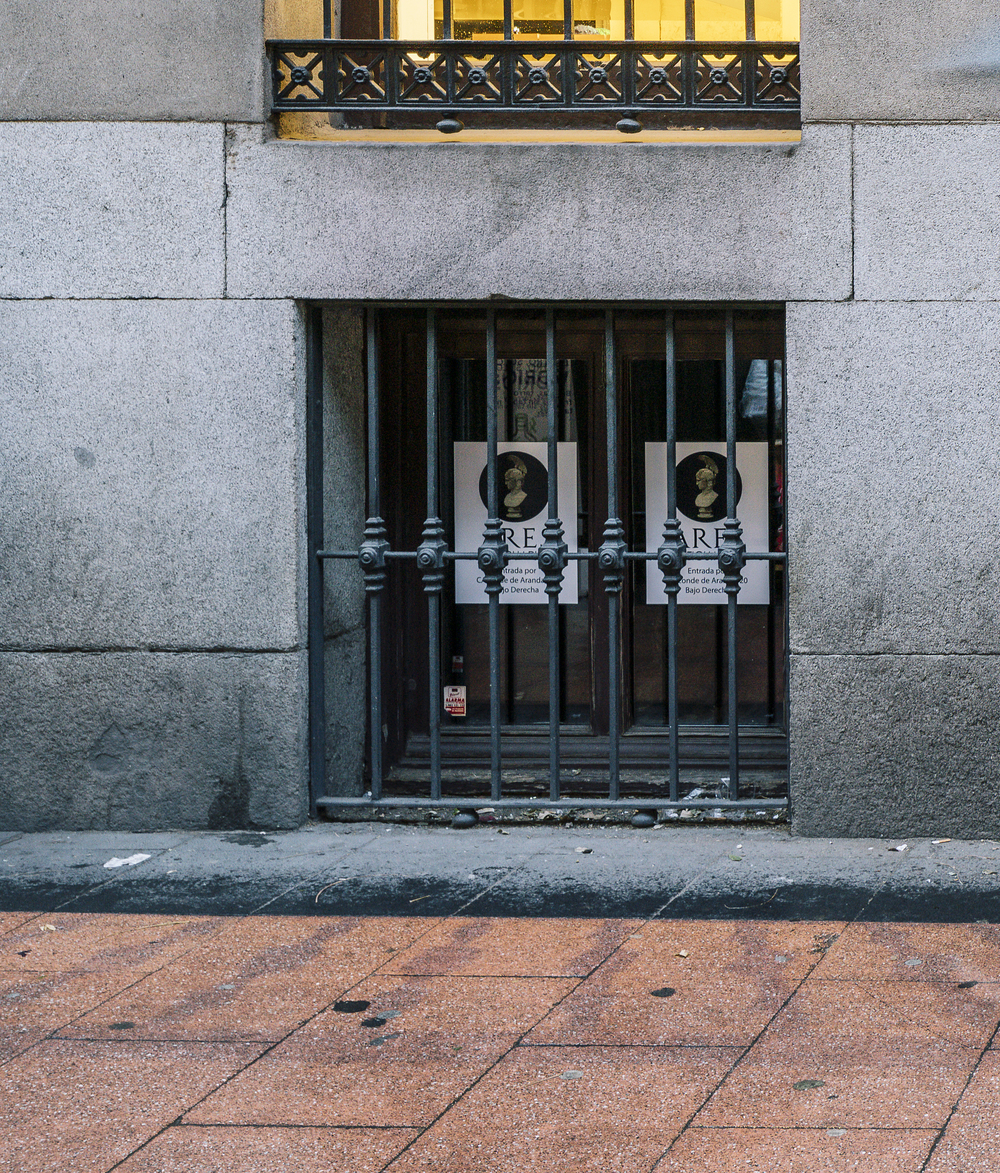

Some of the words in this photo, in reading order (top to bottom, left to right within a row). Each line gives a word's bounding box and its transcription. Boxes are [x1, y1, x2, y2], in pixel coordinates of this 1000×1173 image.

[524, 568, 537, 576] por
[509, 576, 519, 584] de
[510, 586, 540, 594] Derecha
[685, 587, 700, 595] Bajo
